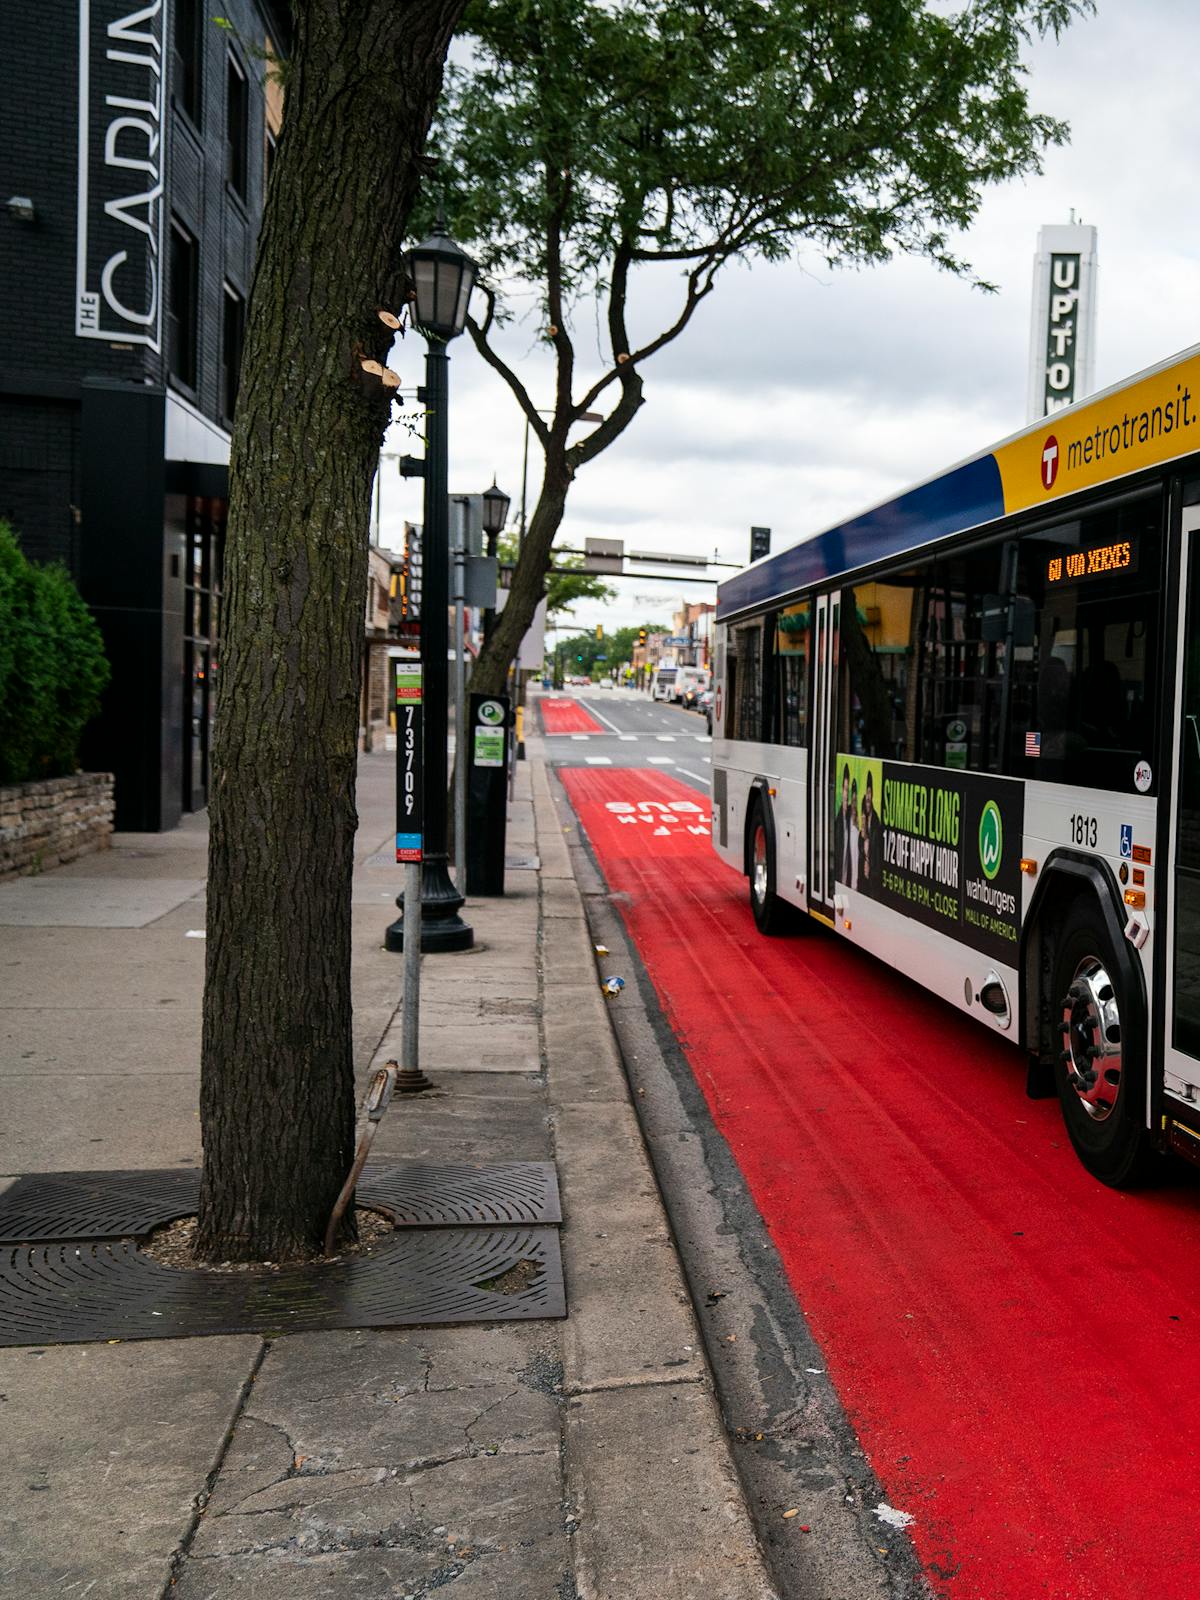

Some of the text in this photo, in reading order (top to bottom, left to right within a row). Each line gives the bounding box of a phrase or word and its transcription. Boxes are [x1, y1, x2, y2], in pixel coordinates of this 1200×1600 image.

[80, 295, 97, 331] THE
[1066, 552, 1086, 578] VIA
[1087, 541, 1131, 574] XERXES
[405, 705, 415, 816] 73709
[604, 800, 705, 814] BUS
[882, 778, 961, 847] SUMMER LONG
[1070, 813, 1098, 849] 1813
[882, 829, 960, 889] 1/2 OFF HAPPY HOUR
[881, 869, 894, 891] 3-6
[965, 877, 1017, 915] wahlburgers
[964, 907, 1018, 943] MALL OF AMERICA
